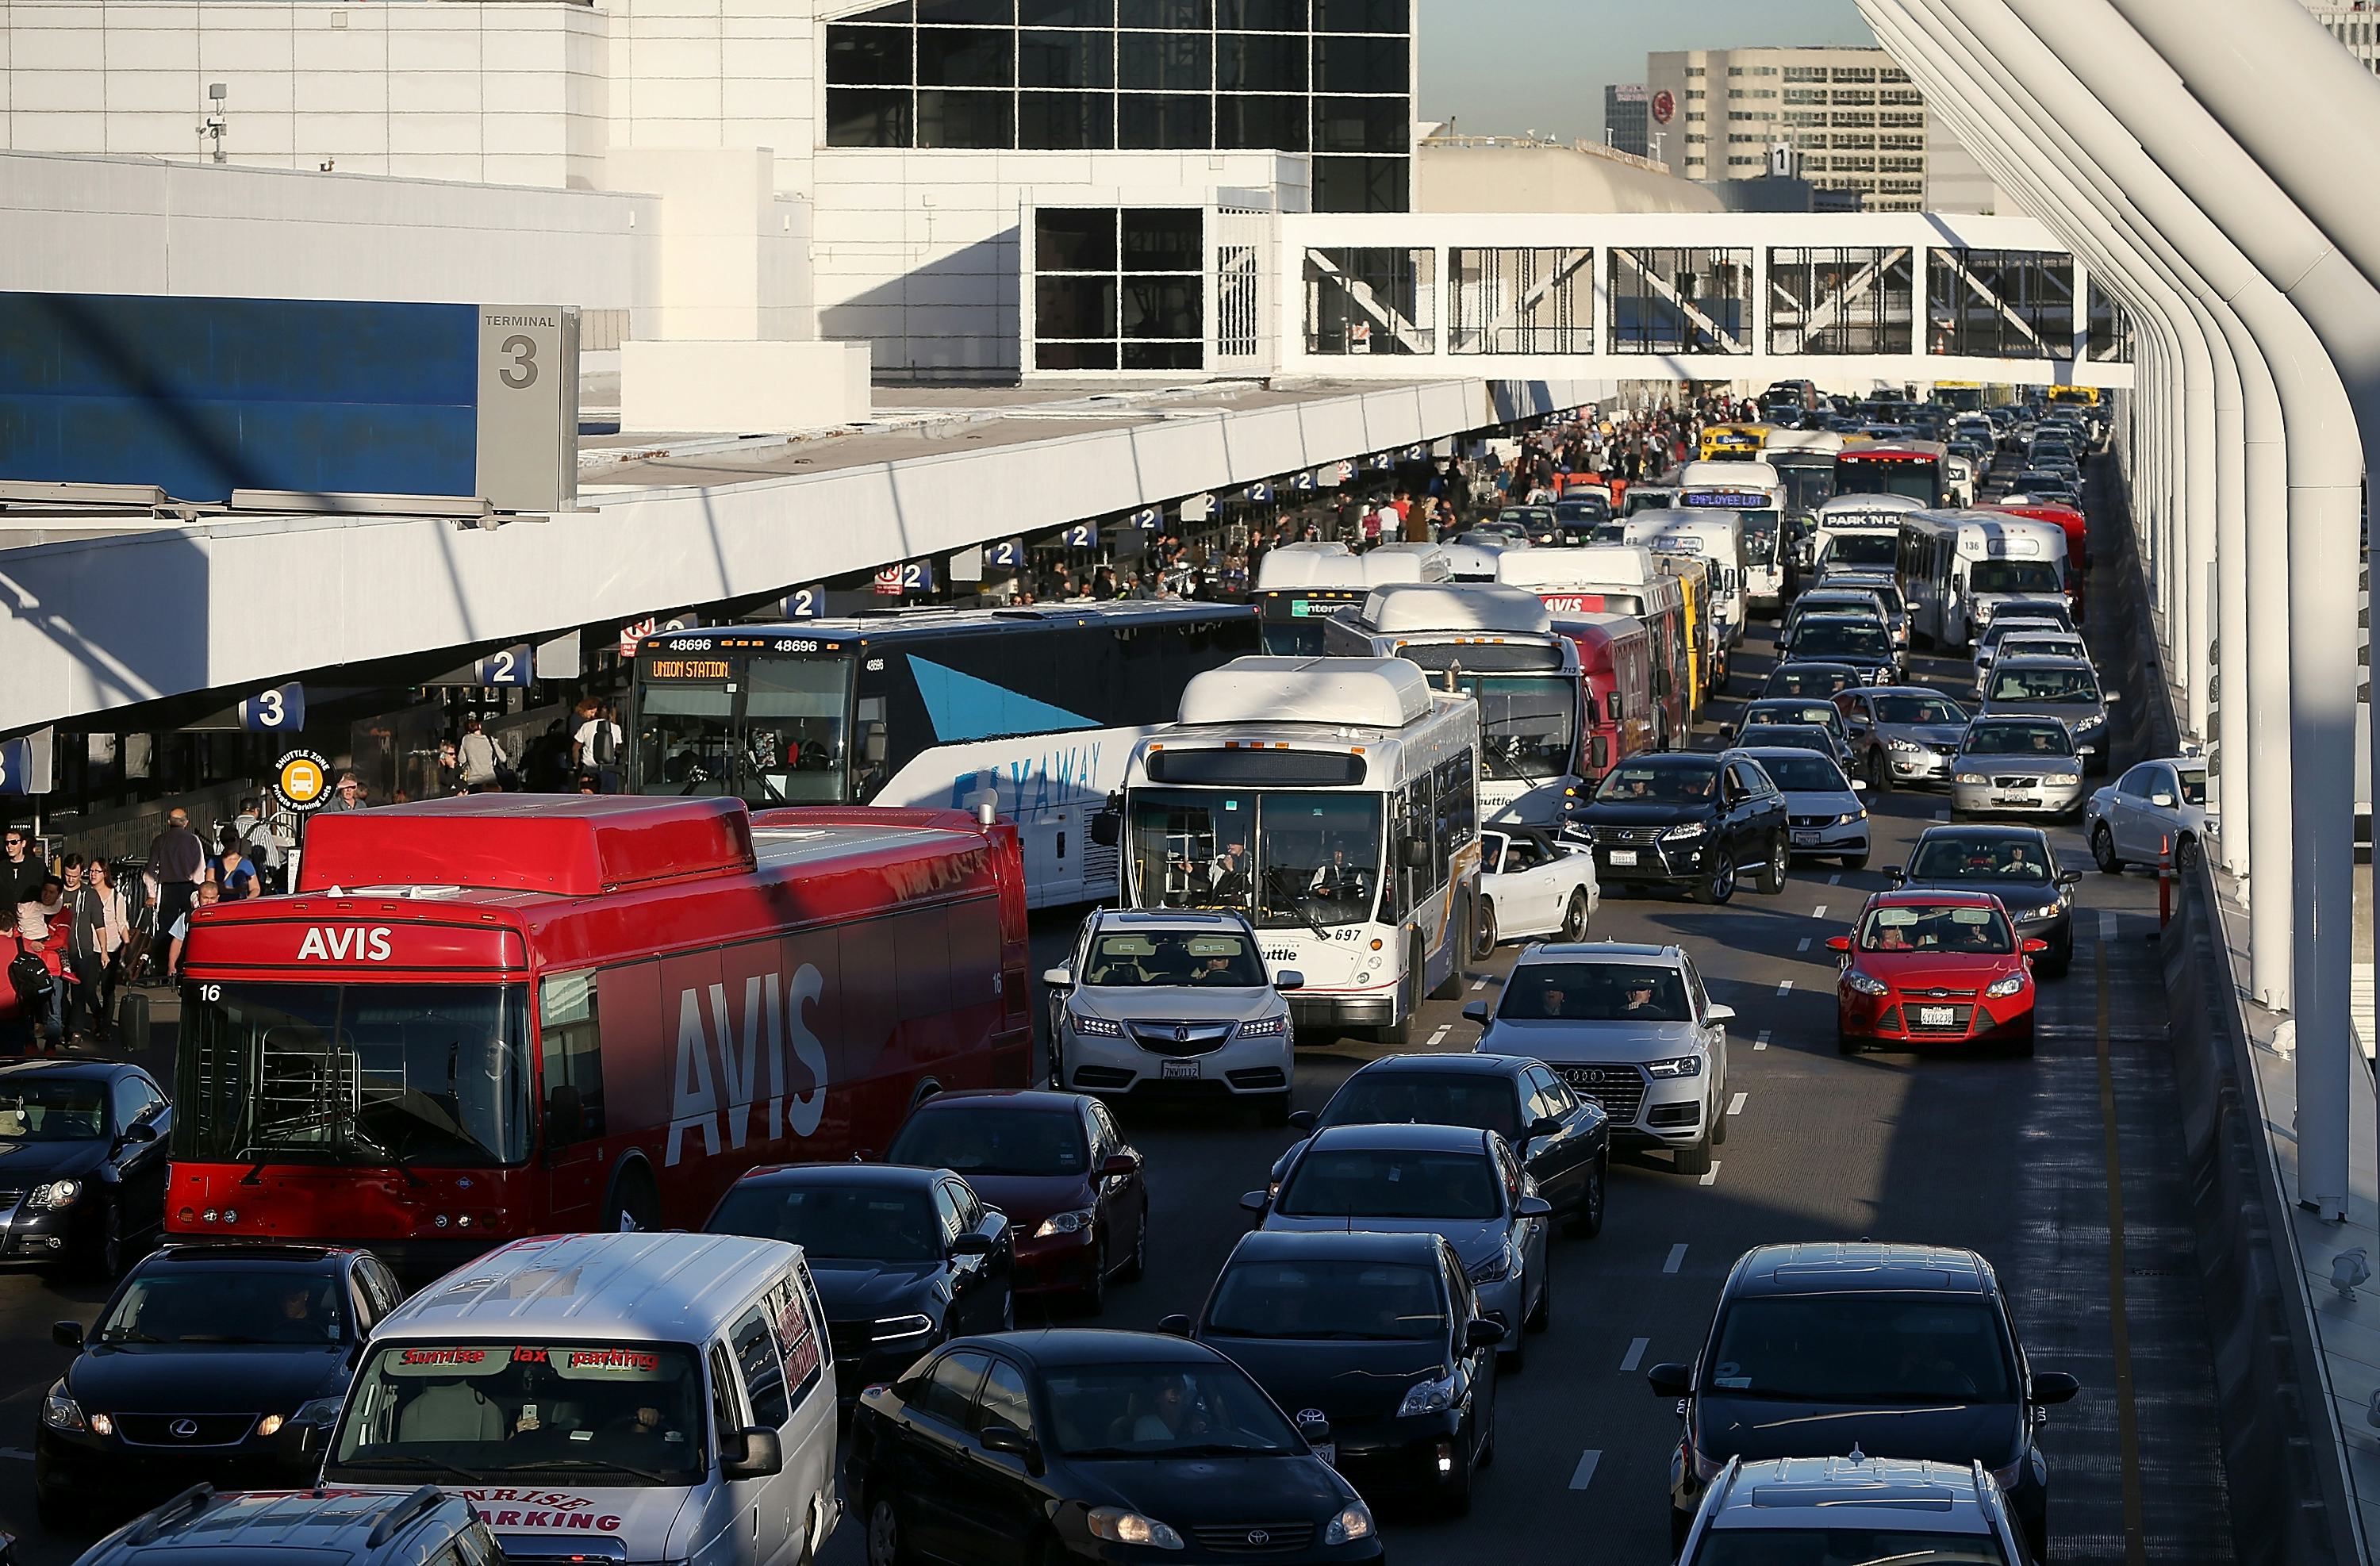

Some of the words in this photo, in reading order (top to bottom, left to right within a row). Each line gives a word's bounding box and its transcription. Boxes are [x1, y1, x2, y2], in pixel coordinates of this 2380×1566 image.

[1776, 148, 1784, 169] 1
[486, 316, 555, 327] TERMINAL
[499, 334, 539, 390] 3
[1549, 413, 1560, 424] 2
[1377, 453, 1388, 470] 2
[1410, 445, 1421, 460] 2
[1299, 472, 1311, 489] 2
[1253, 482, 1265, 500] 2
[1689, 494, 1741, 505] EMPLOYEE
[1742, 495, 1763, 506] LOT
[1204, 494, 1216, 512] 2
[1141, 509, 1155, 528] 2
[1827, 516, 1866, 525] PARK
[1885, 516, 1901, 524] FL
[1073, 525, 1088, 547] 2
[997, 542, 1014, 565] 2
[1965, 542, 1979, 551] 136
[904, 564, 922, 588] 2
[794, 589, 813, 616] 2
[1297, 604, 1336, 613] enter
[1544, 597, 1583, 612] AVIS
[669, 639, 712, 651] 48696
[774, 640, 818, 652] 48696
[493, 651, 515, 681] 2
[653, 661, 684, 677] UNION
[685, 661, 729, 678] STATION
[259, 689, 285, 727] 3
[275, 750, 309, 770] SHUTTLE
[310, 752, 330, 771] ZONE
[272, 783, 291, 807] Private
[291, 800, 321, 811] Parking
[320, 785, 332, 802] Lots
[1477, 797, 1512, 806] huttle
[298, 927, 391, 961] AVIS
[1335, 929, 1361, 942] 697
[1262, 949, 1297, 960] uttle
[199, 984, 221, 1001] 16
[992, 973, 1002, 994] 16
[665, 962, 828, 1167] AVIS
[404, 1347, 486, 1364] Sunrise
[513, 1345, 547, 1362] lax
[573, 1347, 659, 1372] parking
[459, 1489, 595, 1511] NRISE
[477, 1510, 622, 1532] ARKING
